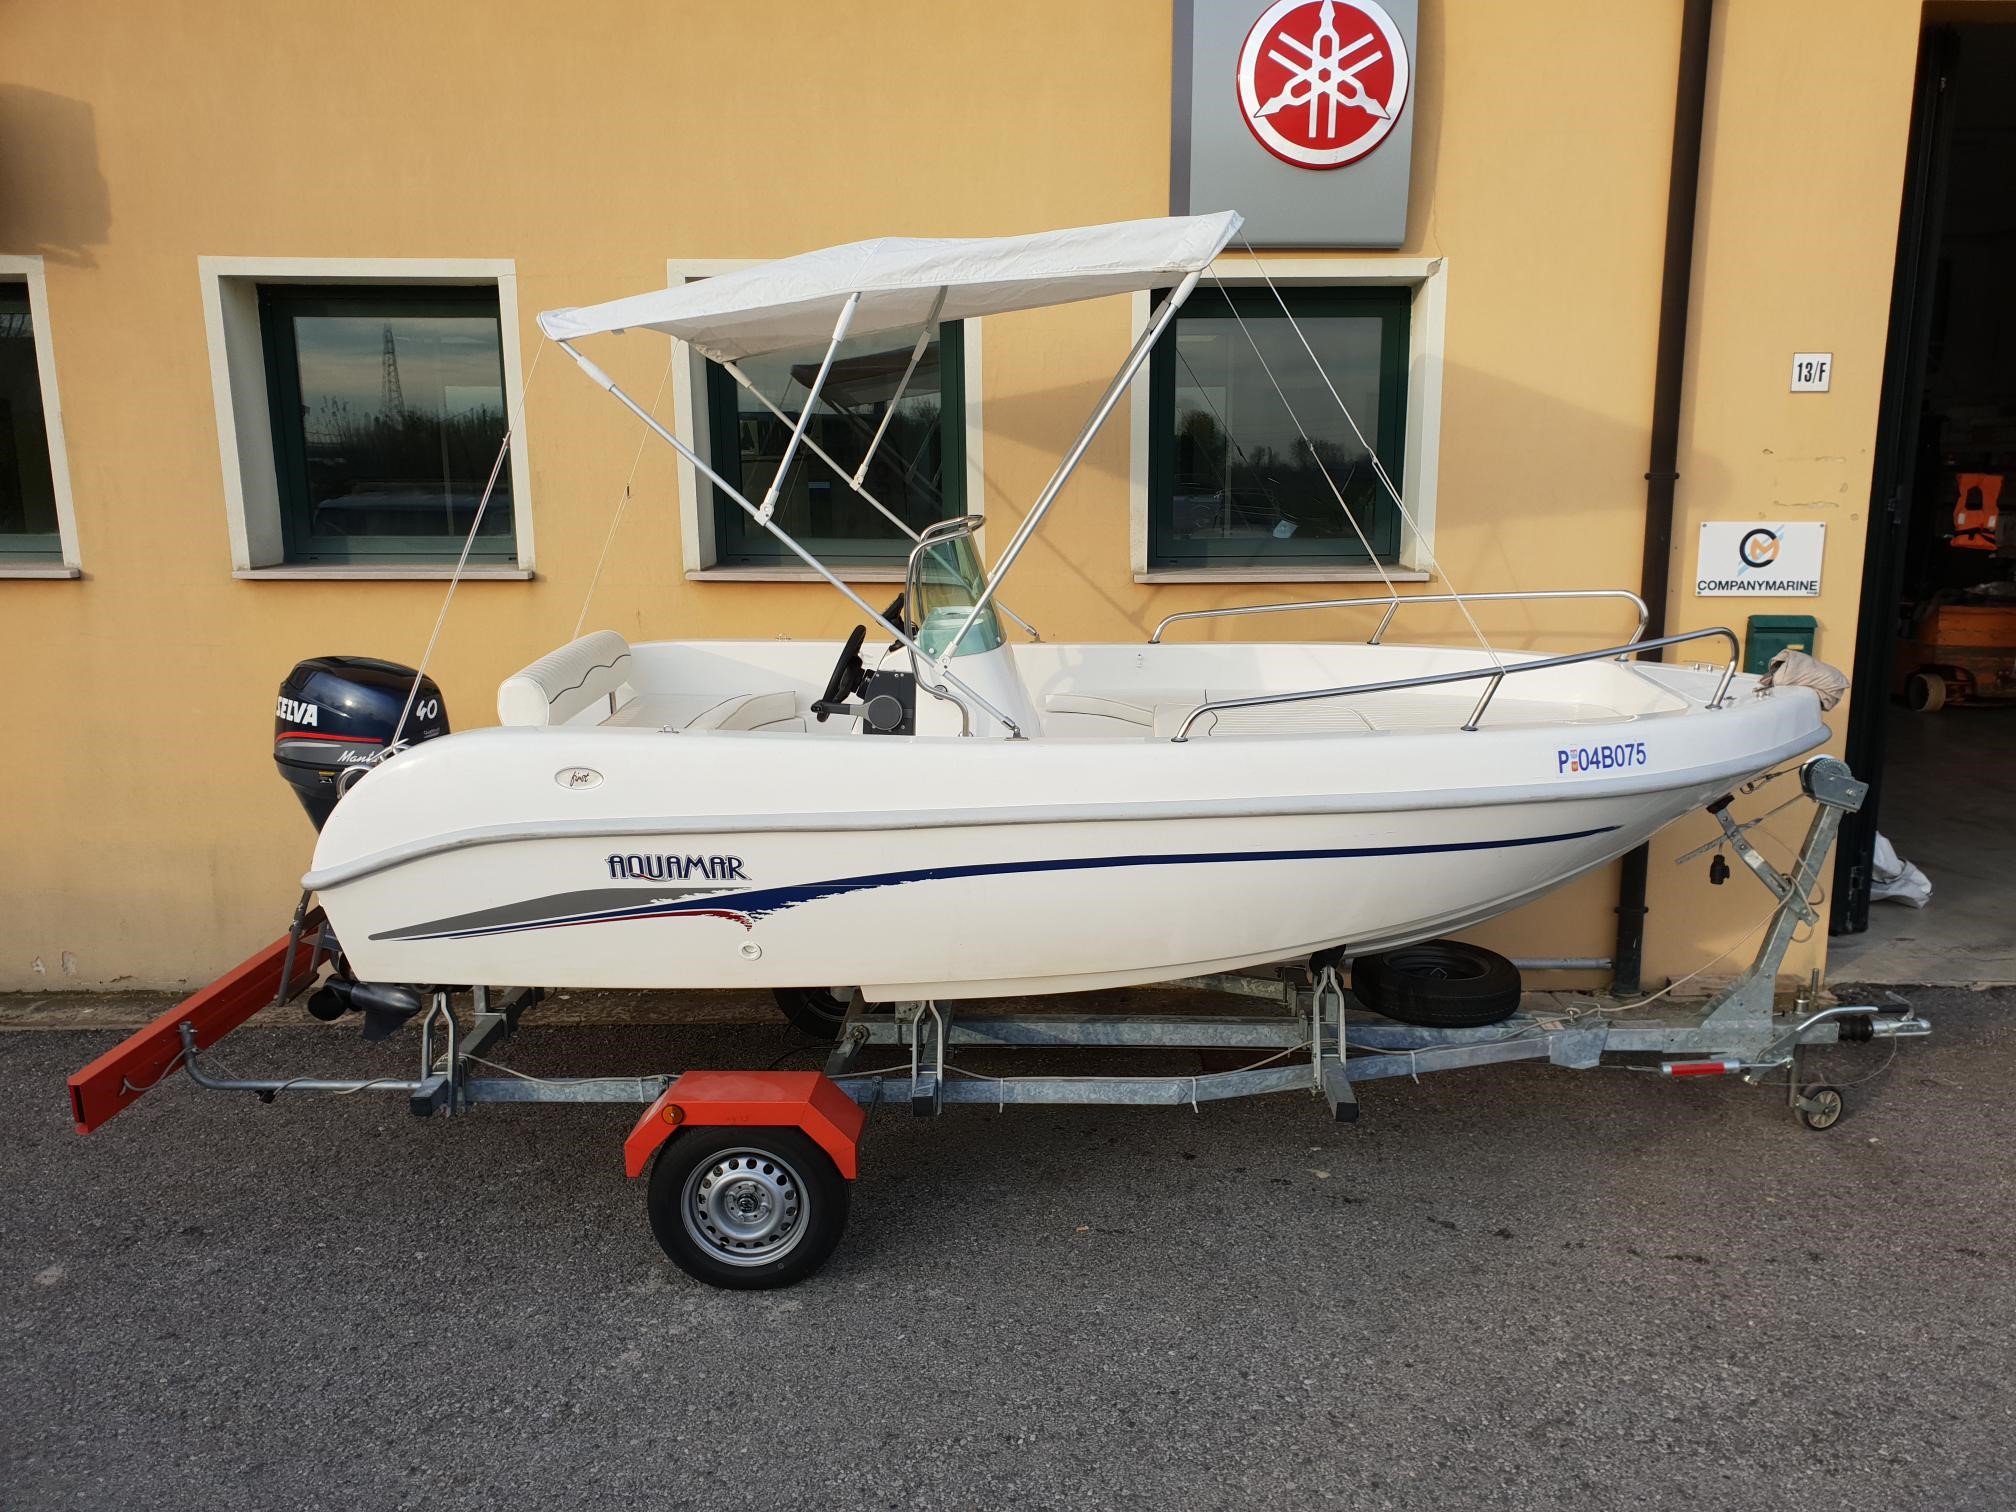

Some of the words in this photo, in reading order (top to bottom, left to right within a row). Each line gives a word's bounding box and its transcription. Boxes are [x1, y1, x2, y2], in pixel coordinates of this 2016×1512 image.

[1796, 361, 1827, 384] 13/F
[1697, 580, 1818, 592] COMPANYMARINE
[276, 696, 318, 727] SELVA
[416, 699, 438, 721] 40
[605, 853, 752, 882] AQUAMAR
